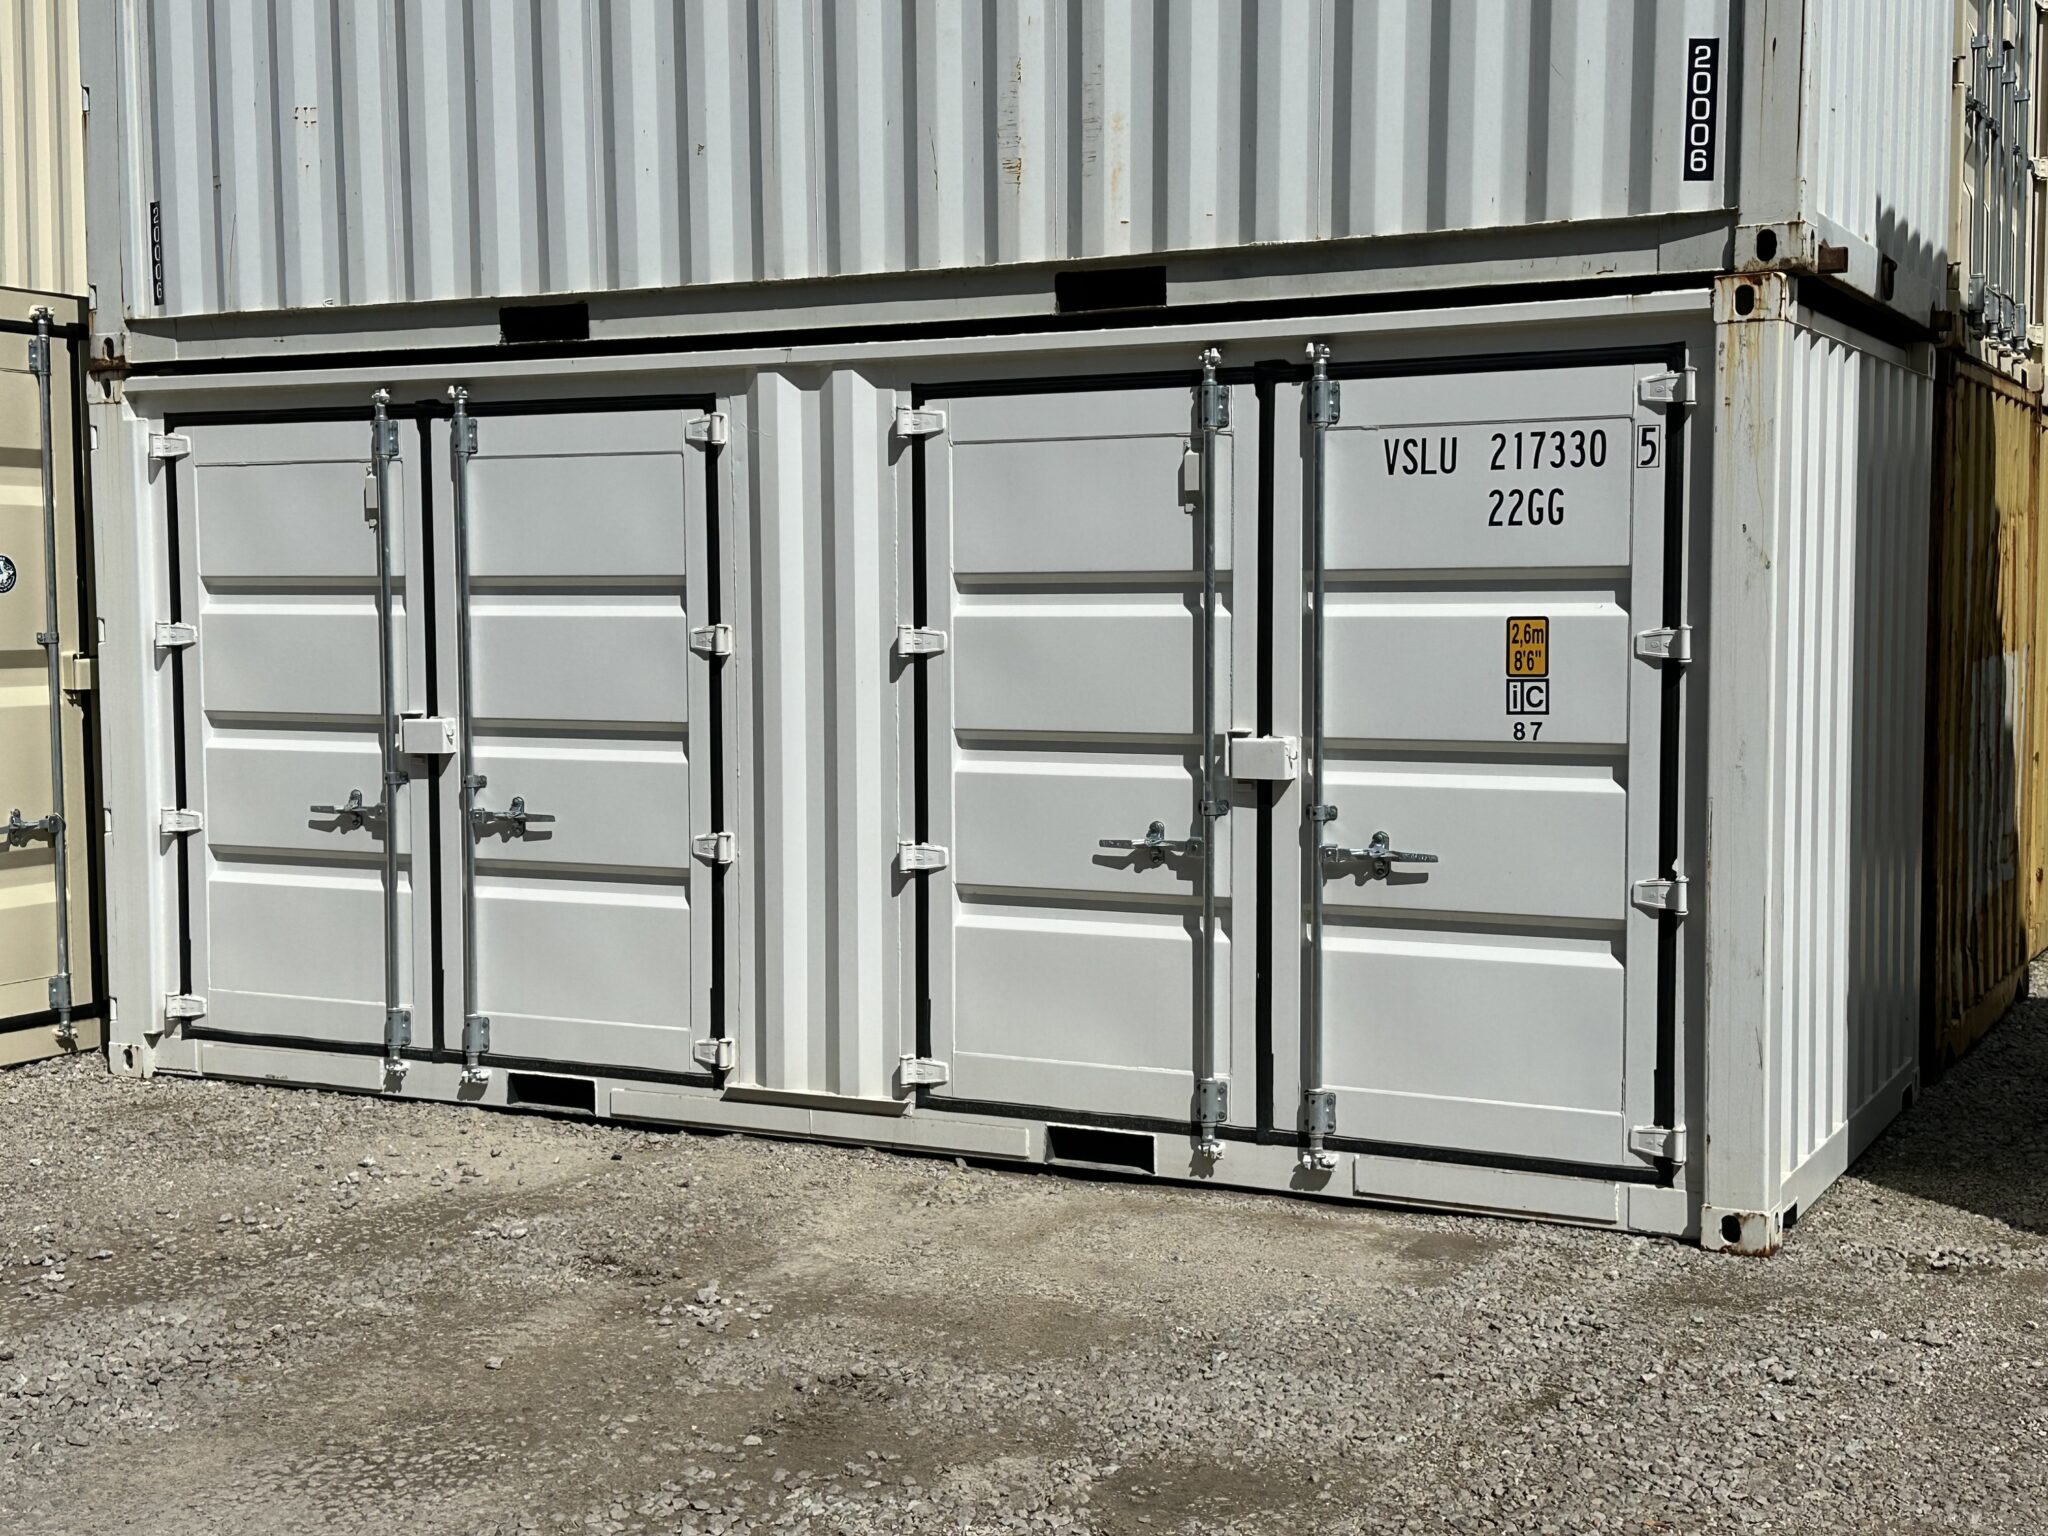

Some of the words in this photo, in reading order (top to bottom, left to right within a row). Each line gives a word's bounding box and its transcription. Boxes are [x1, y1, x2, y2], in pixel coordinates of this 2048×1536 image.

[1690, 45, 1712, 173] 20006
[153, 206, 163, 299] 20006
[1383, 436, 1458, 476] VSLU
[1489, 428, 1608, 471] 217330
[1640, 427, 1657, 466] 5
[1487, 487, 1565, 527] 22GG
[1511, 623, 1545, 648] 2,6m
[1513, 650, 1542, 672] 8'6"
[1512, 722, 1543, 741] 87
